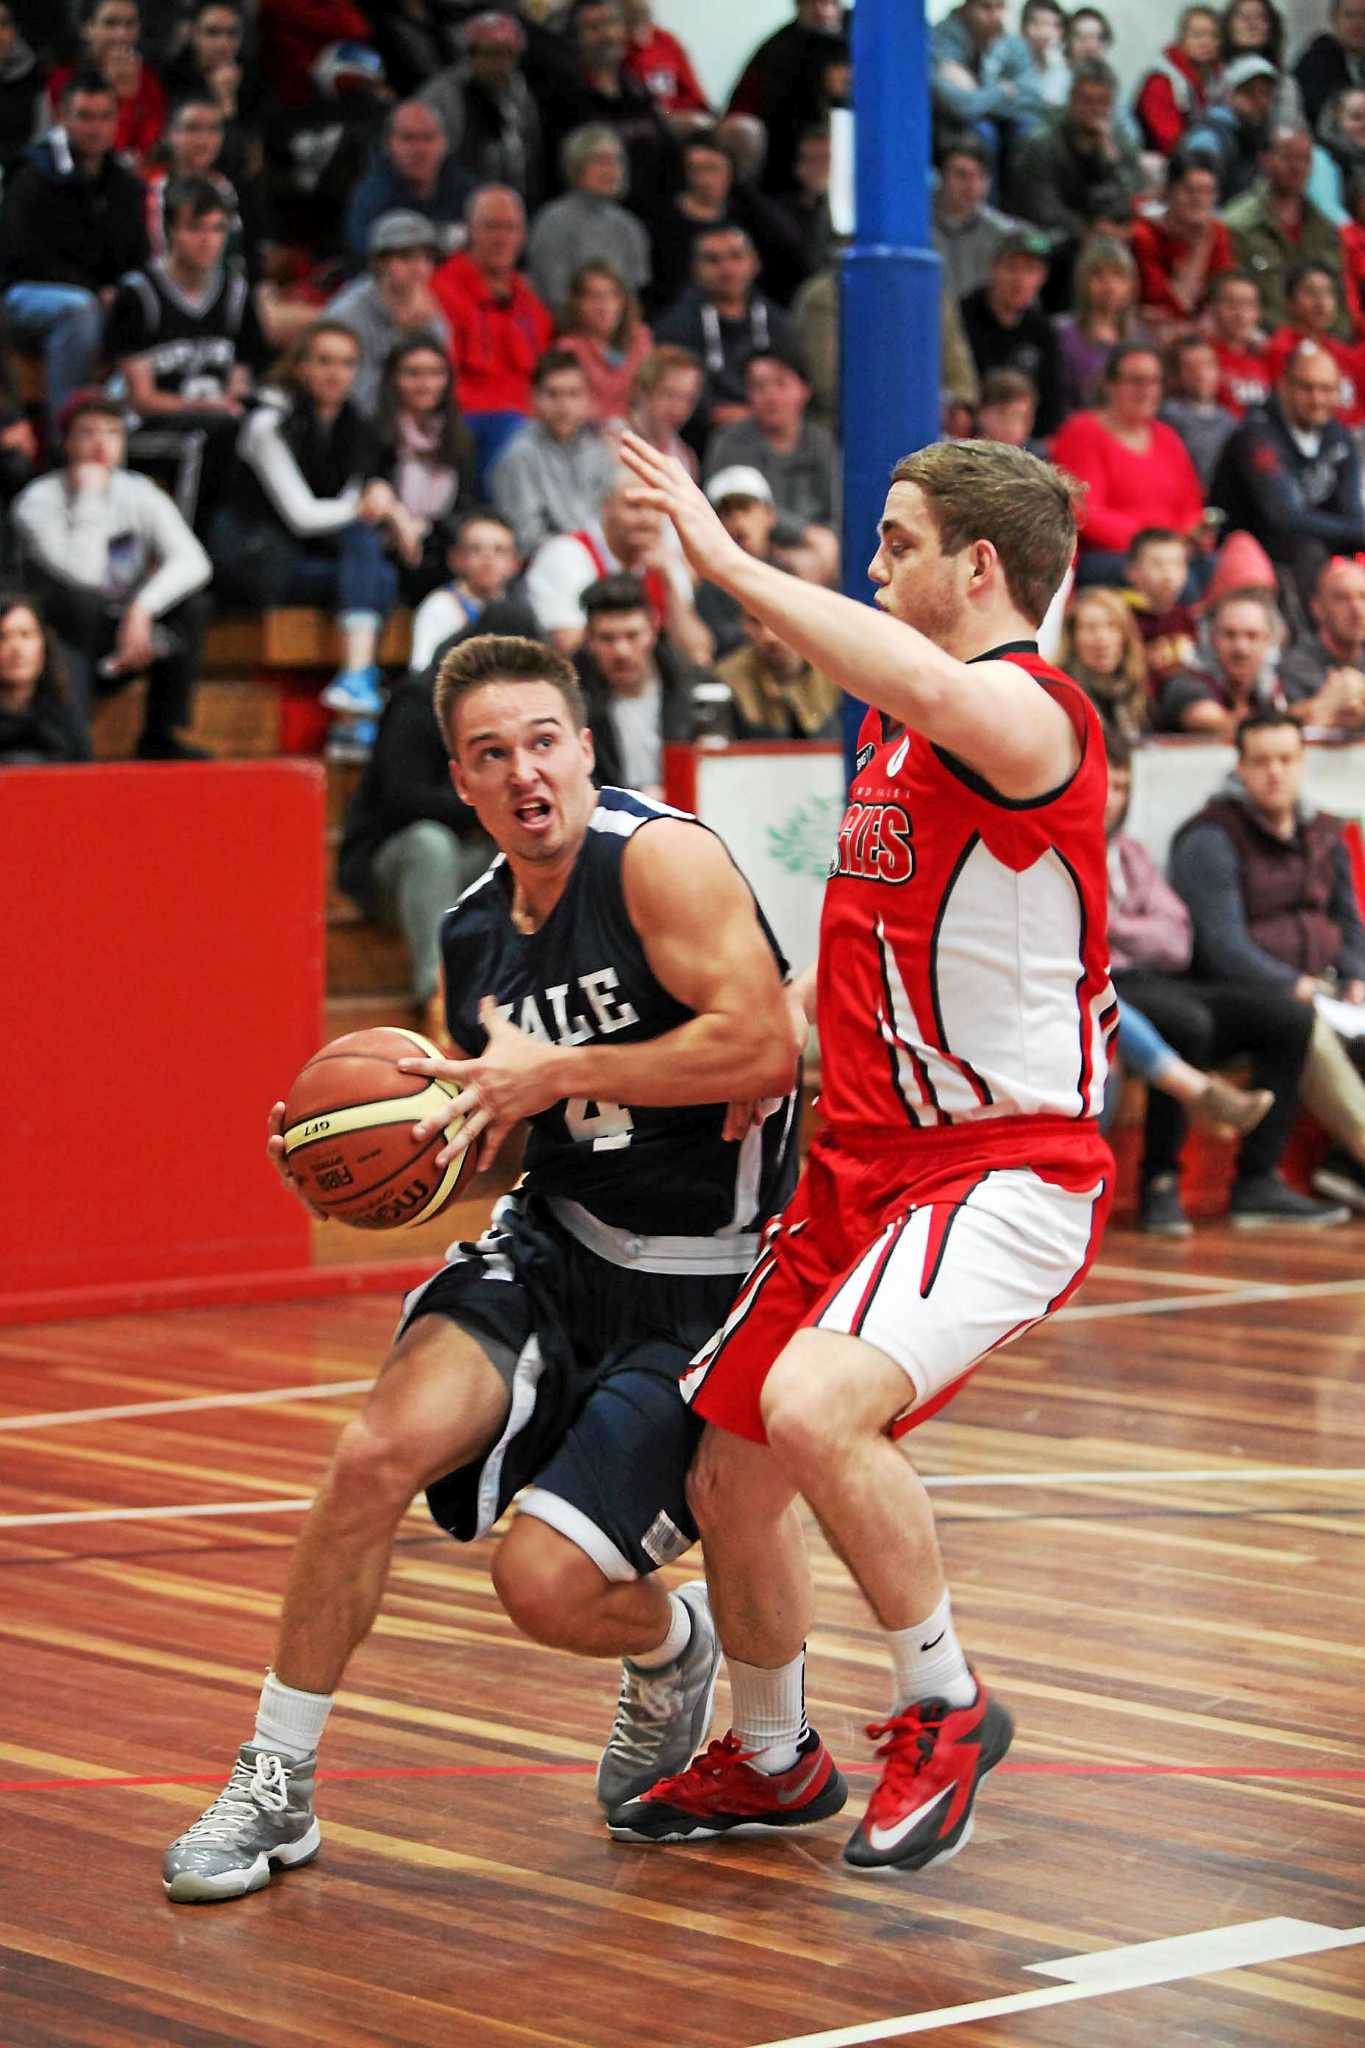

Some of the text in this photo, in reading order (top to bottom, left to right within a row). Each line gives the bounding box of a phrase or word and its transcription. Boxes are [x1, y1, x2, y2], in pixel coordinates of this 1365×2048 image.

[478, 966, 641, 1047] ALE
[303, 1120, 330, 1137] GF7
[564, 1097, 635, 1152] 4
